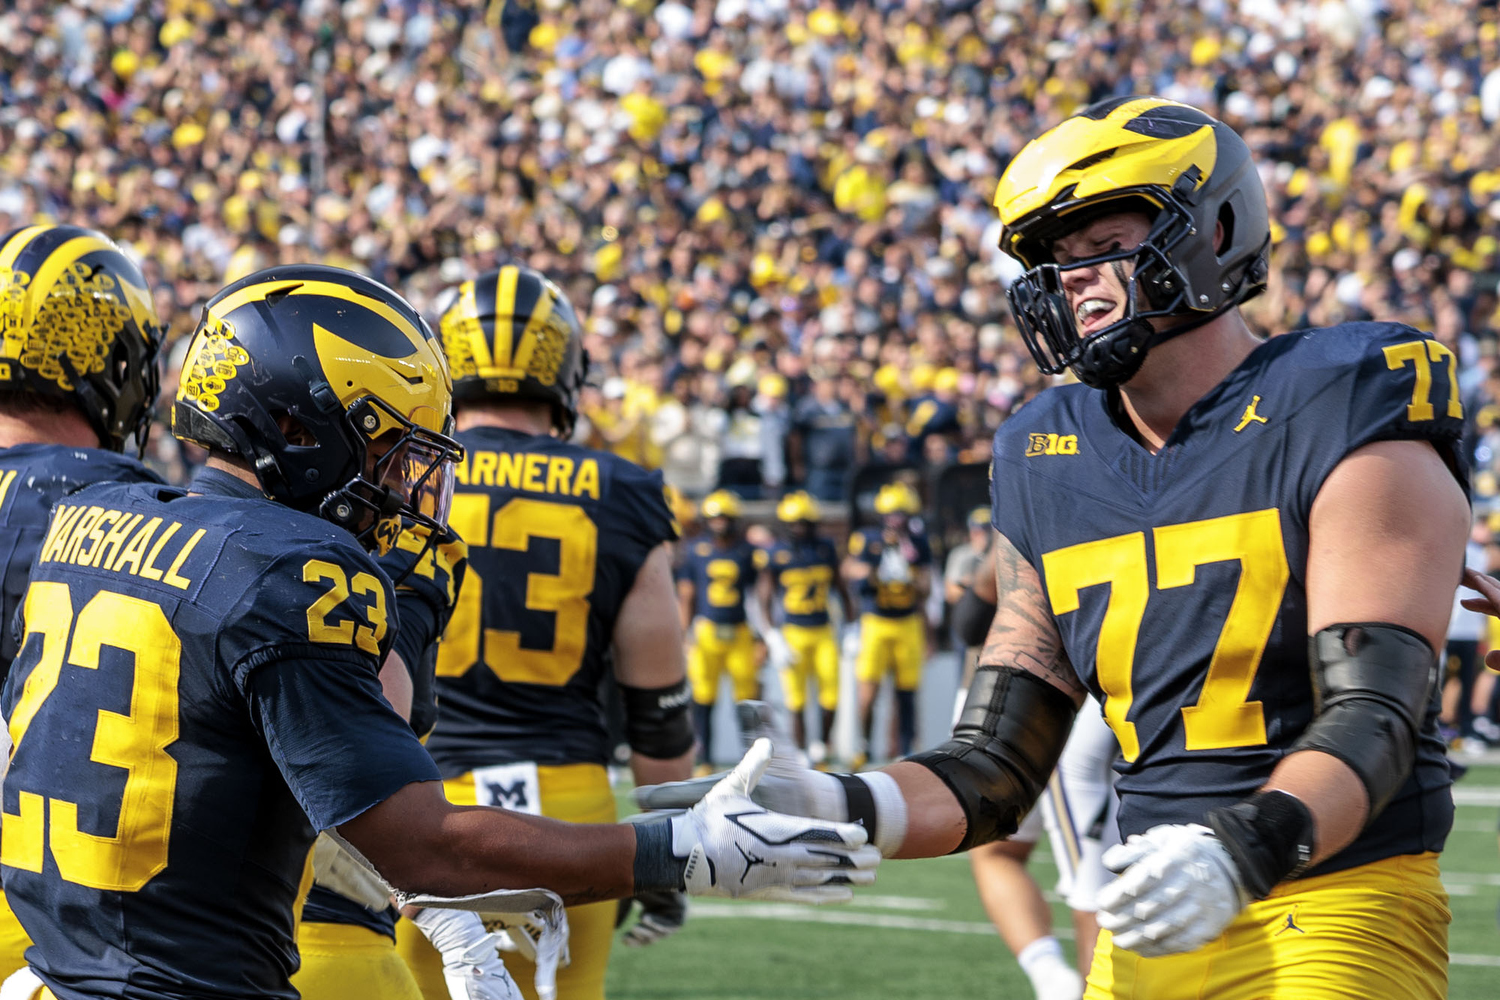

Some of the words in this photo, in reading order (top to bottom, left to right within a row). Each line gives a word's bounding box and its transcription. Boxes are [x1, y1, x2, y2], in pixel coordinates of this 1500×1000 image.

[1383, 340, 1463, 422] 77
[302, 558, 390, 655] 23
[1041, 508, 1290, 763] 77
[0, 581, 182, 892] 23
[484, 781, 528, 807] M
